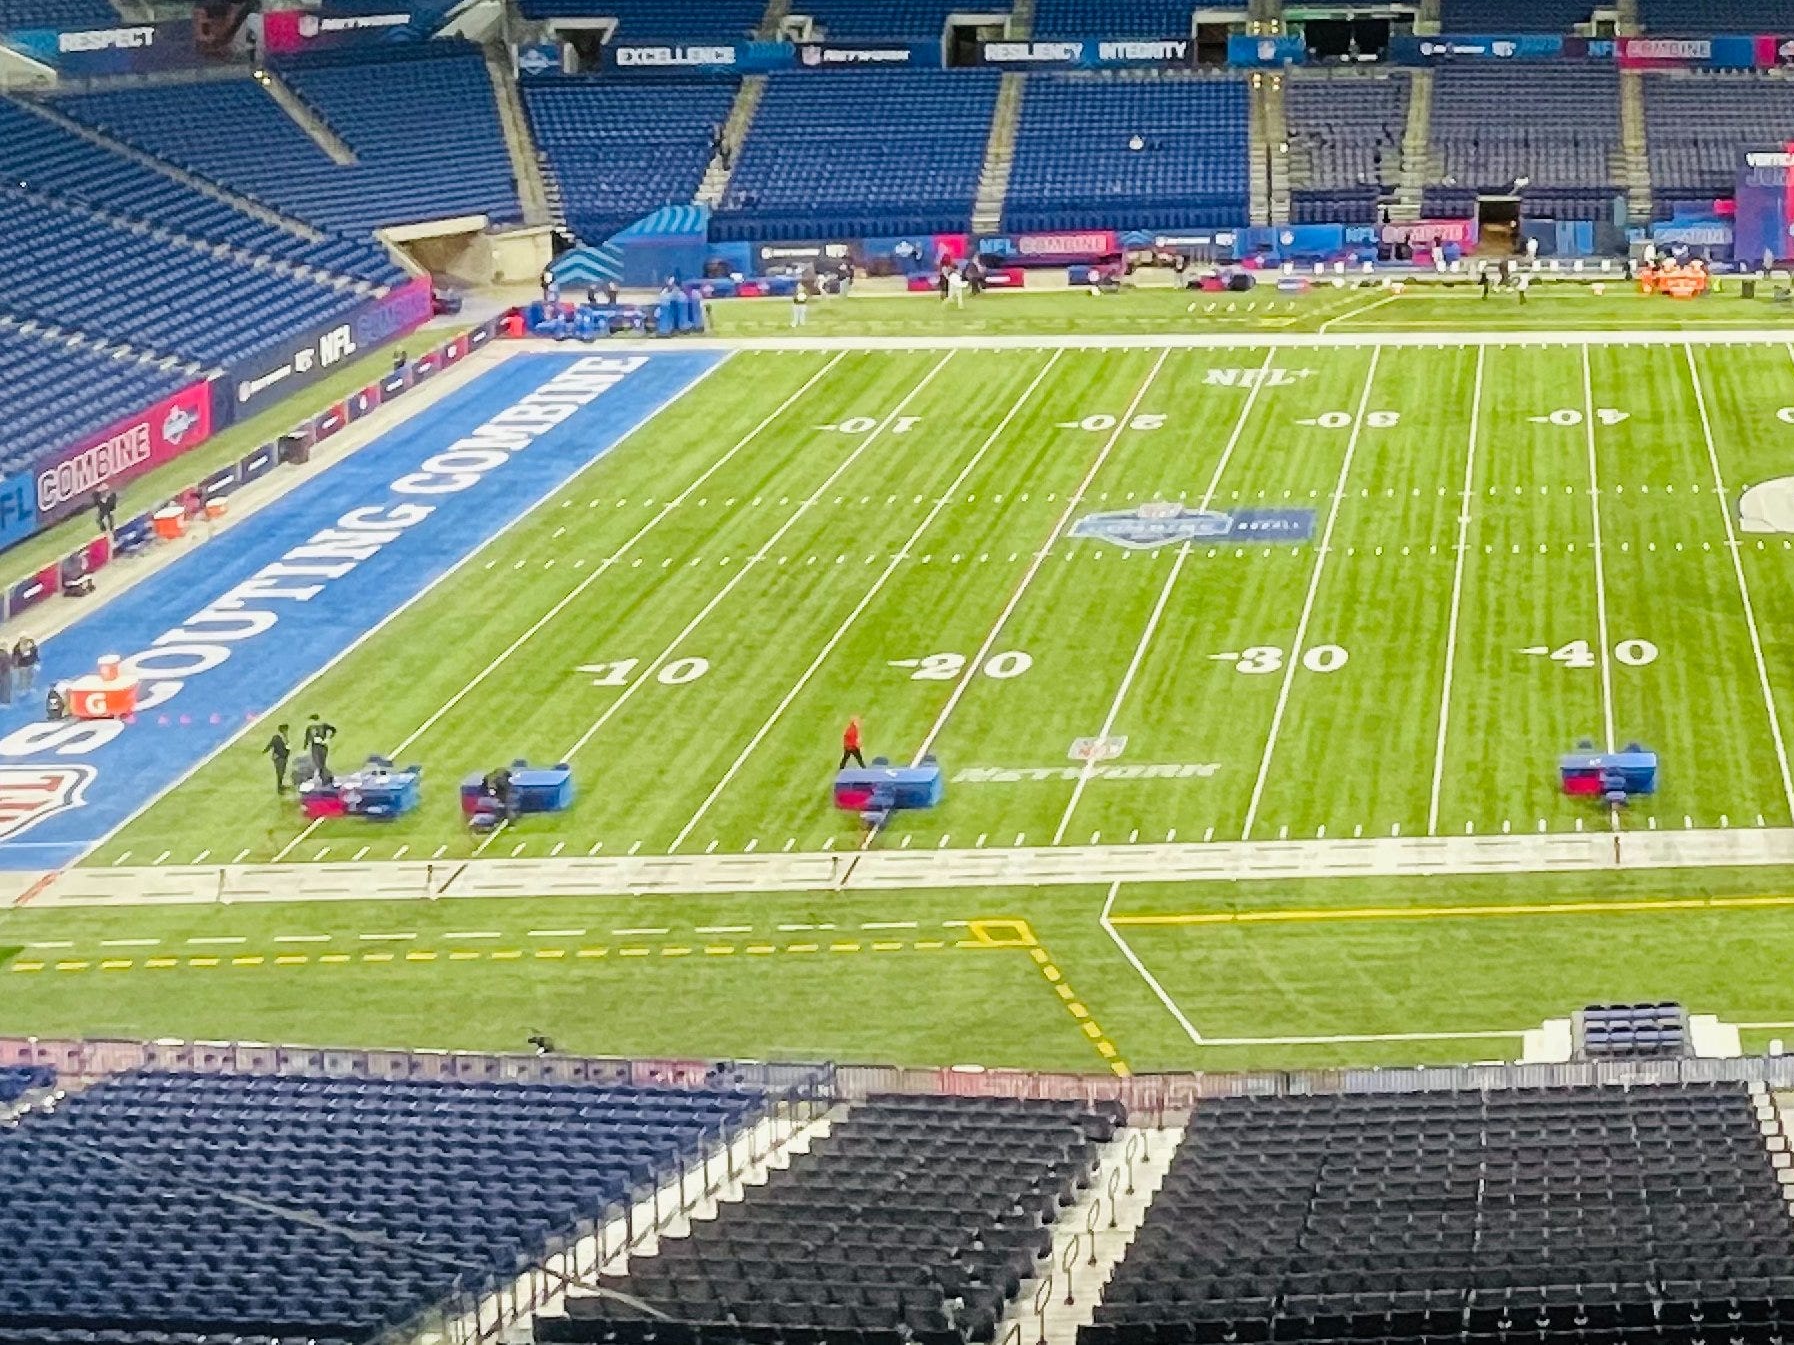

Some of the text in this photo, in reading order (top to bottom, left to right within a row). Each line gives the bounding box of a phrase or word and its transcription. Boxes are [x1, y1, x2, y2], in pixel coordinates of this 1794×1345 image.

[58, 26, 154, 52] RESPECT
[1099, 41, 1187, 60] INTEGRITY
[1588, 40, 1623, 58] NFL
[616, 46, 735, 65] EXCELLENCE
[979, 235, 1107, 254] NFL COMBINE
[319, 324, 356, 368] NFL
[391, 356, 650, 495] COMBINE
[37, 422, 151, 512] COMBINE
[911, 651, 1033, 680] 20
[1234, 644, 1349, 674] 30
[1549, 638, 1658, 667] 40
[593, 657, 708, 687] 10
[85, 693, 107, 715] G
[951, 763, 1222, 782] NETWORK
